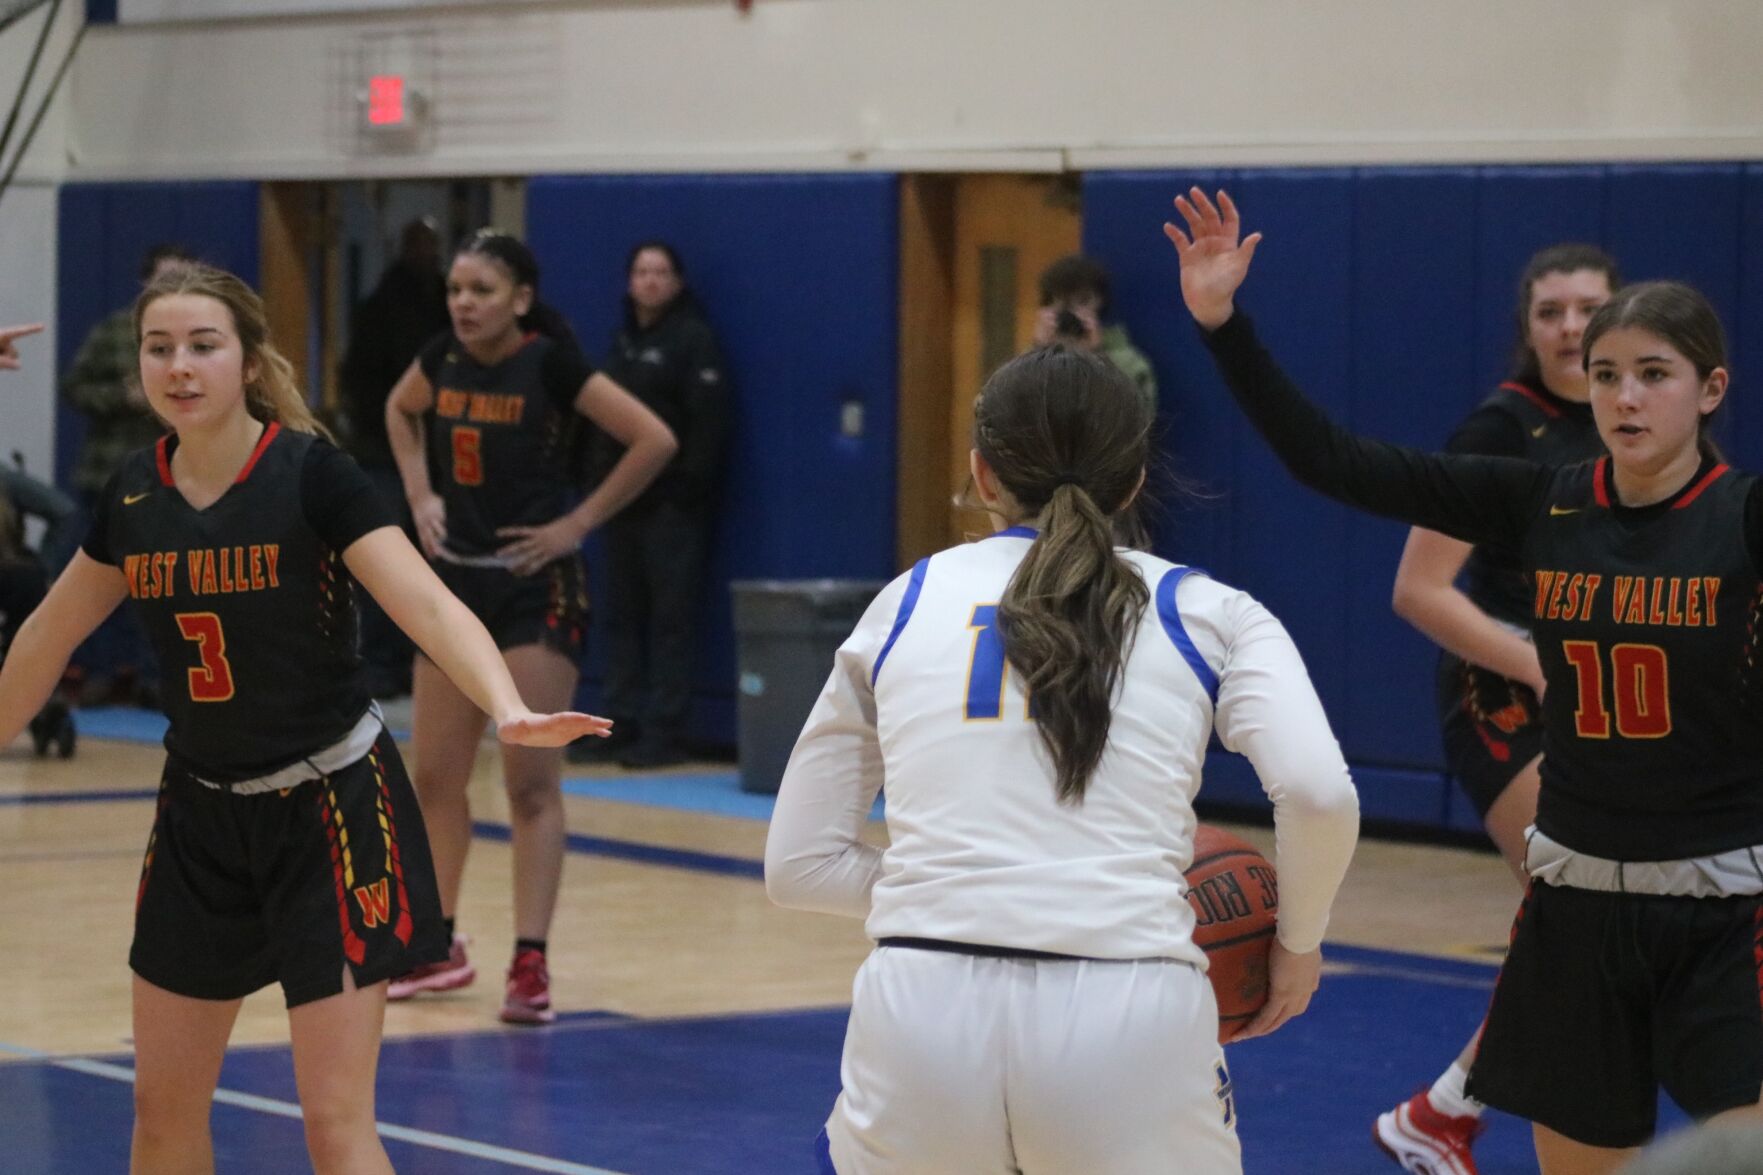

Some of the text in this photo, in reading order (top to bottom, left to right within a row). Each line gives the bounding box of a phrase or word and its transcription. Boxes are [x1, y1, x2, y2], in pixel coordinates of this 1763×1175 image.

[452, 425, 483, 486] 5
[124, 543, 280, 599] WEST VALLEY
[1535, 570, 1721, 627] WEST VALLEY
[175, 611, 235, 702] 3
[962, 602, 1038, 722] 1
[1562, 640, 1672, 739] 10
[353, 877, 390, 929] W
